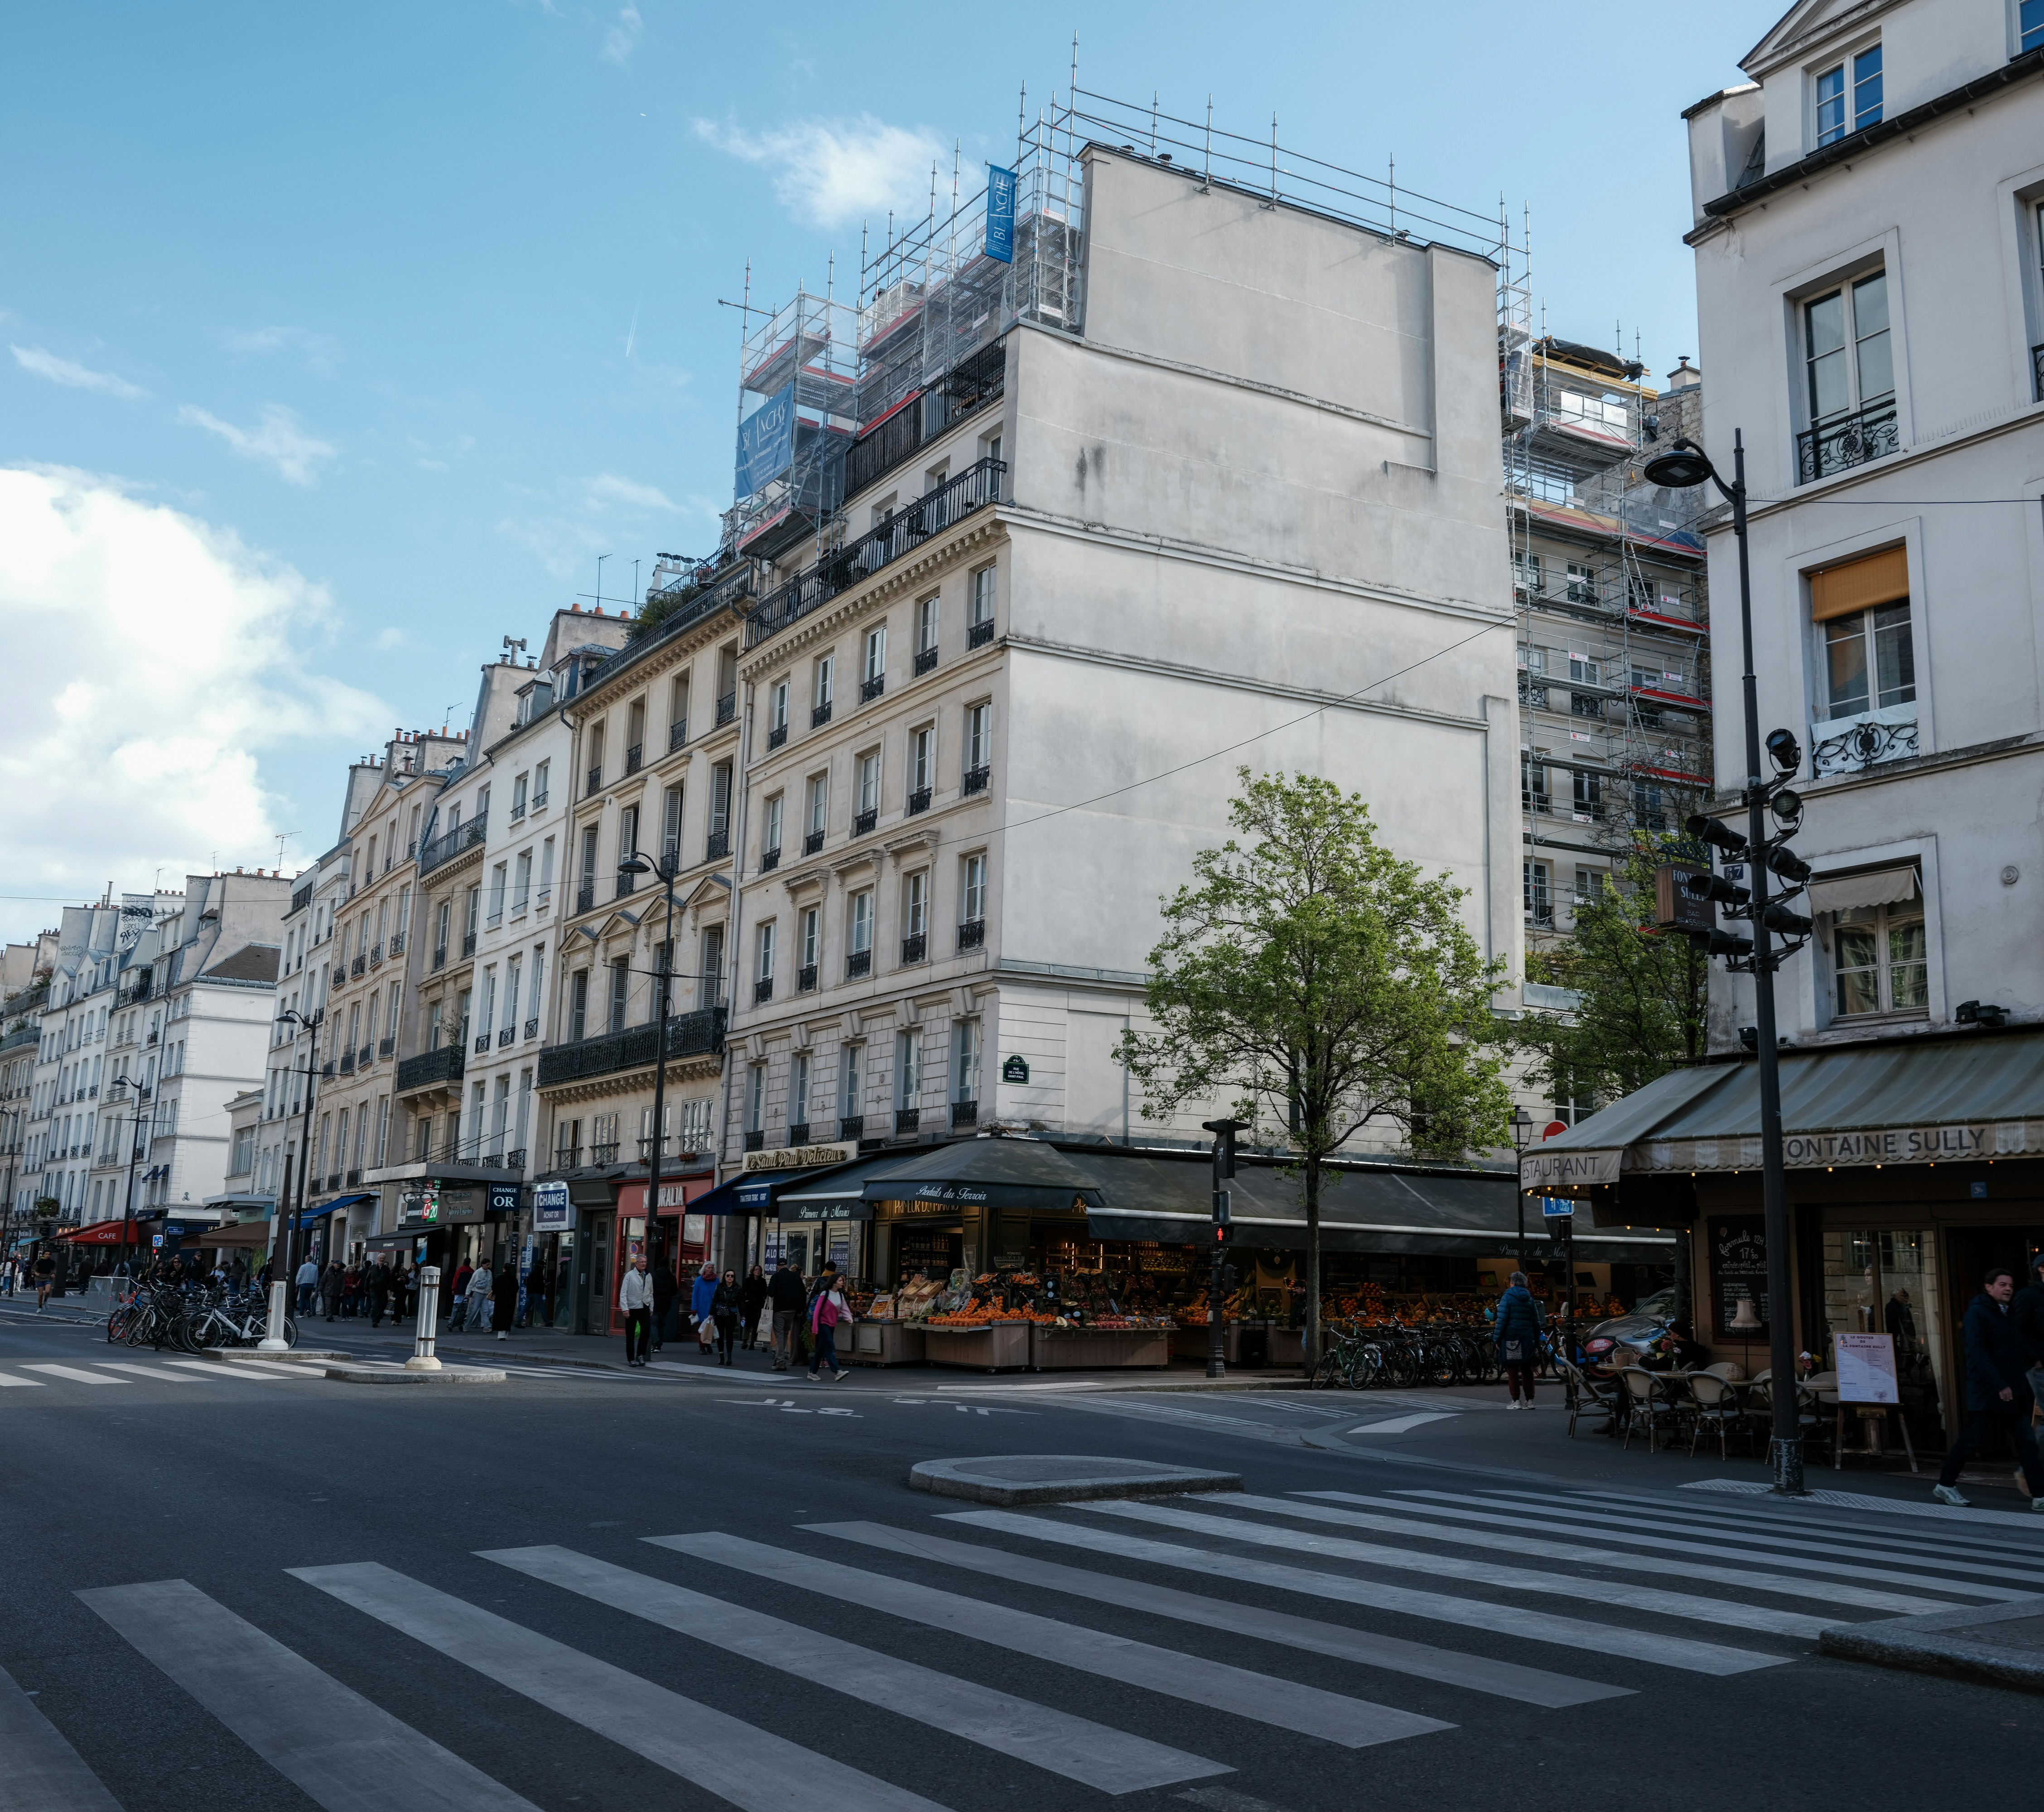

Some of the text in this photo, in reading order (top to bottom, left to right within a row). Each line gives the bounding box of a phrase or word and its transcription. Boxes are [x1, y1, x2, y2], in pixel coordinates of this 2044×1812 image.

[989, 175, 1013, 241] BLANCHE
[1047, 307, 1062, 316] plettac
[1782, 1128, 1986, 1158] ONTAINE SULLY
[745, 1155, 755, 1170] Le
[756, 1151, 777, 1169] Saint
[778, 1149, 799, 1167] Paul
[539, 1192, 565, 1206] CHANGE
[916, 1186, 987, 1200] Produits du Terroir
[493, 1196, 515, 1207] OR
[429, 1205, 438, 1218] 20
[820, 1206, 827, 1218] du
[1498, 1243, 1527, 1256] Primer
[1533, 1246, 1543, 1256] du
[1719, 1230, 1765, 1257] formule 12H
[766, 1249, 786, 1258] A LOER
[1739, 1247, 1750, 1259] 17
